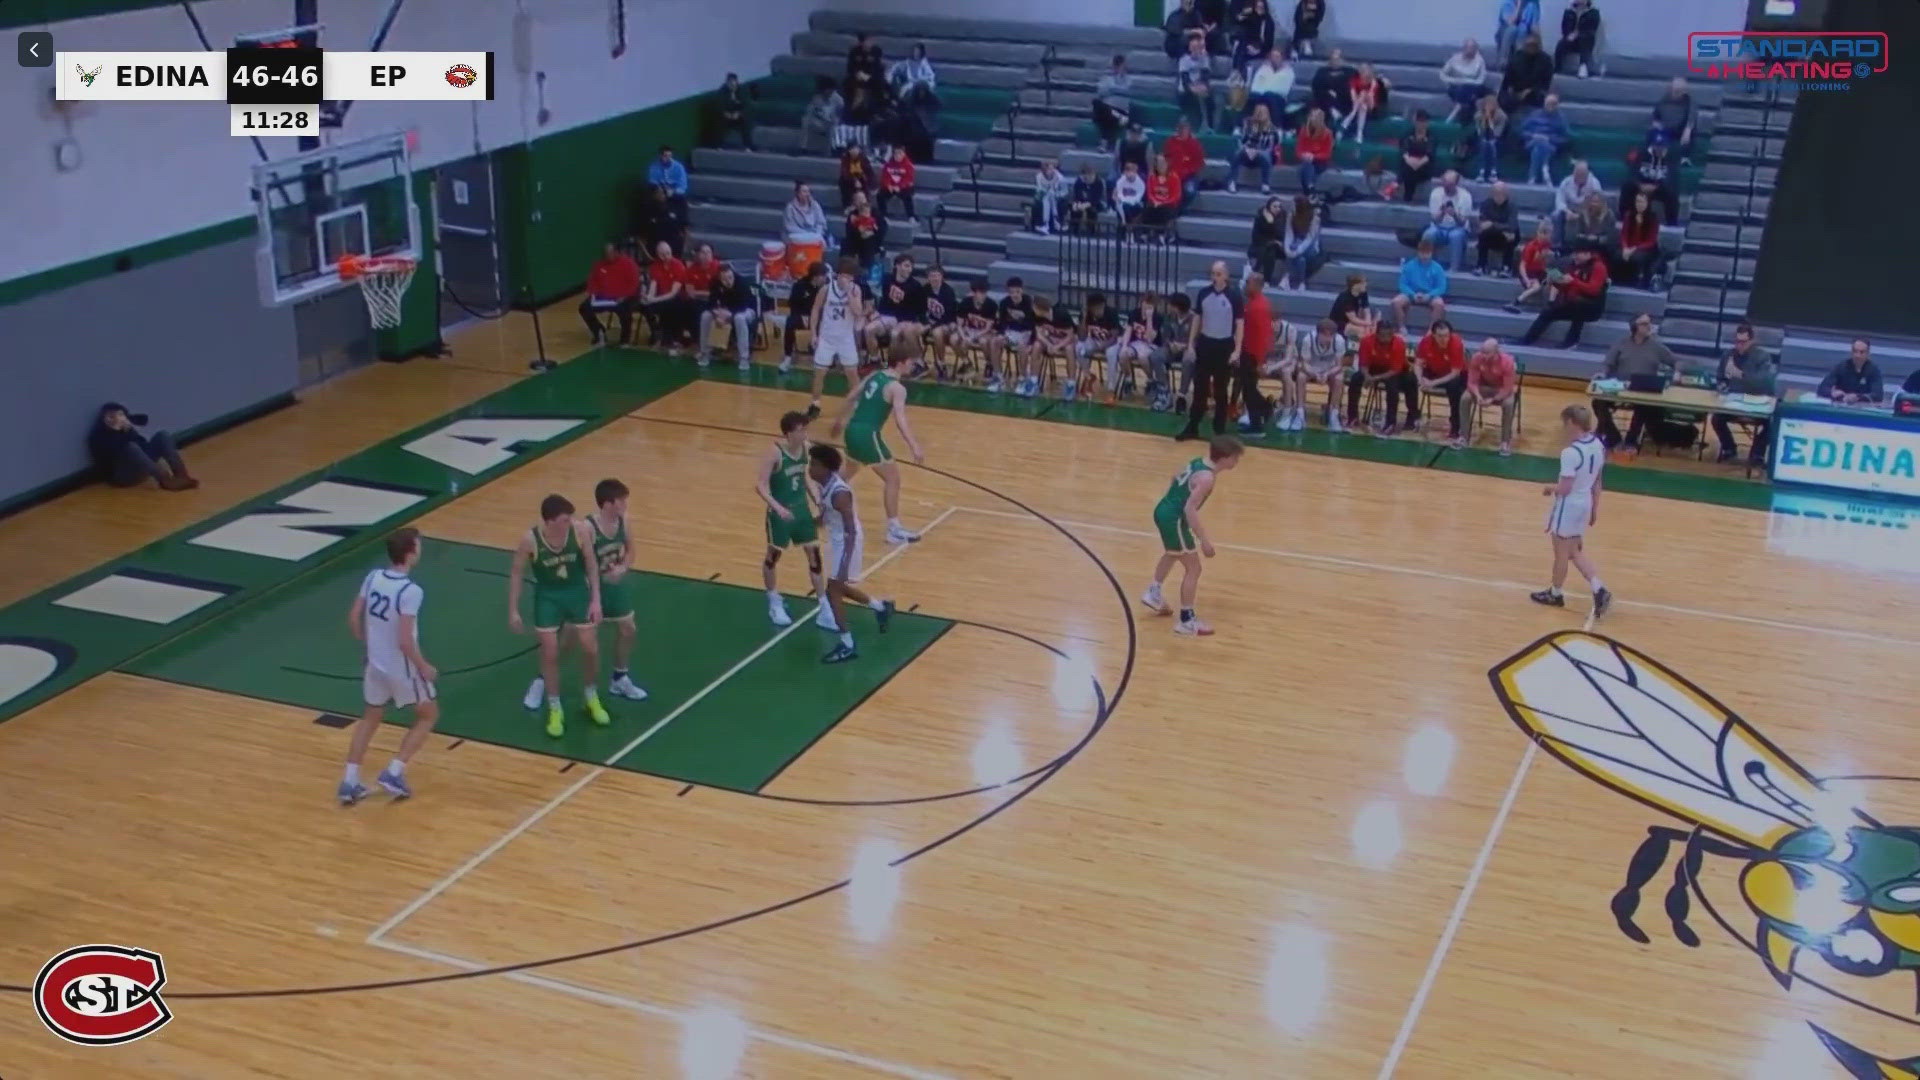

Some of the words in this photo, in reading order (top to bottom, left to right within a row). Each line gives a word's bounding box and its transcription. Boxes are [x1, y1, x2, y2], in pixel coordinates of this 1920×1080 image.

[832, 307, 846, 321] 24
[865, 380, 879, 400] 3
[1588, 453, 1595, 475] 1
[1780, 435, 1915, 478] EDINA
[556, 564, 569, 579] 4
[369, 591, 391, 622] 22
